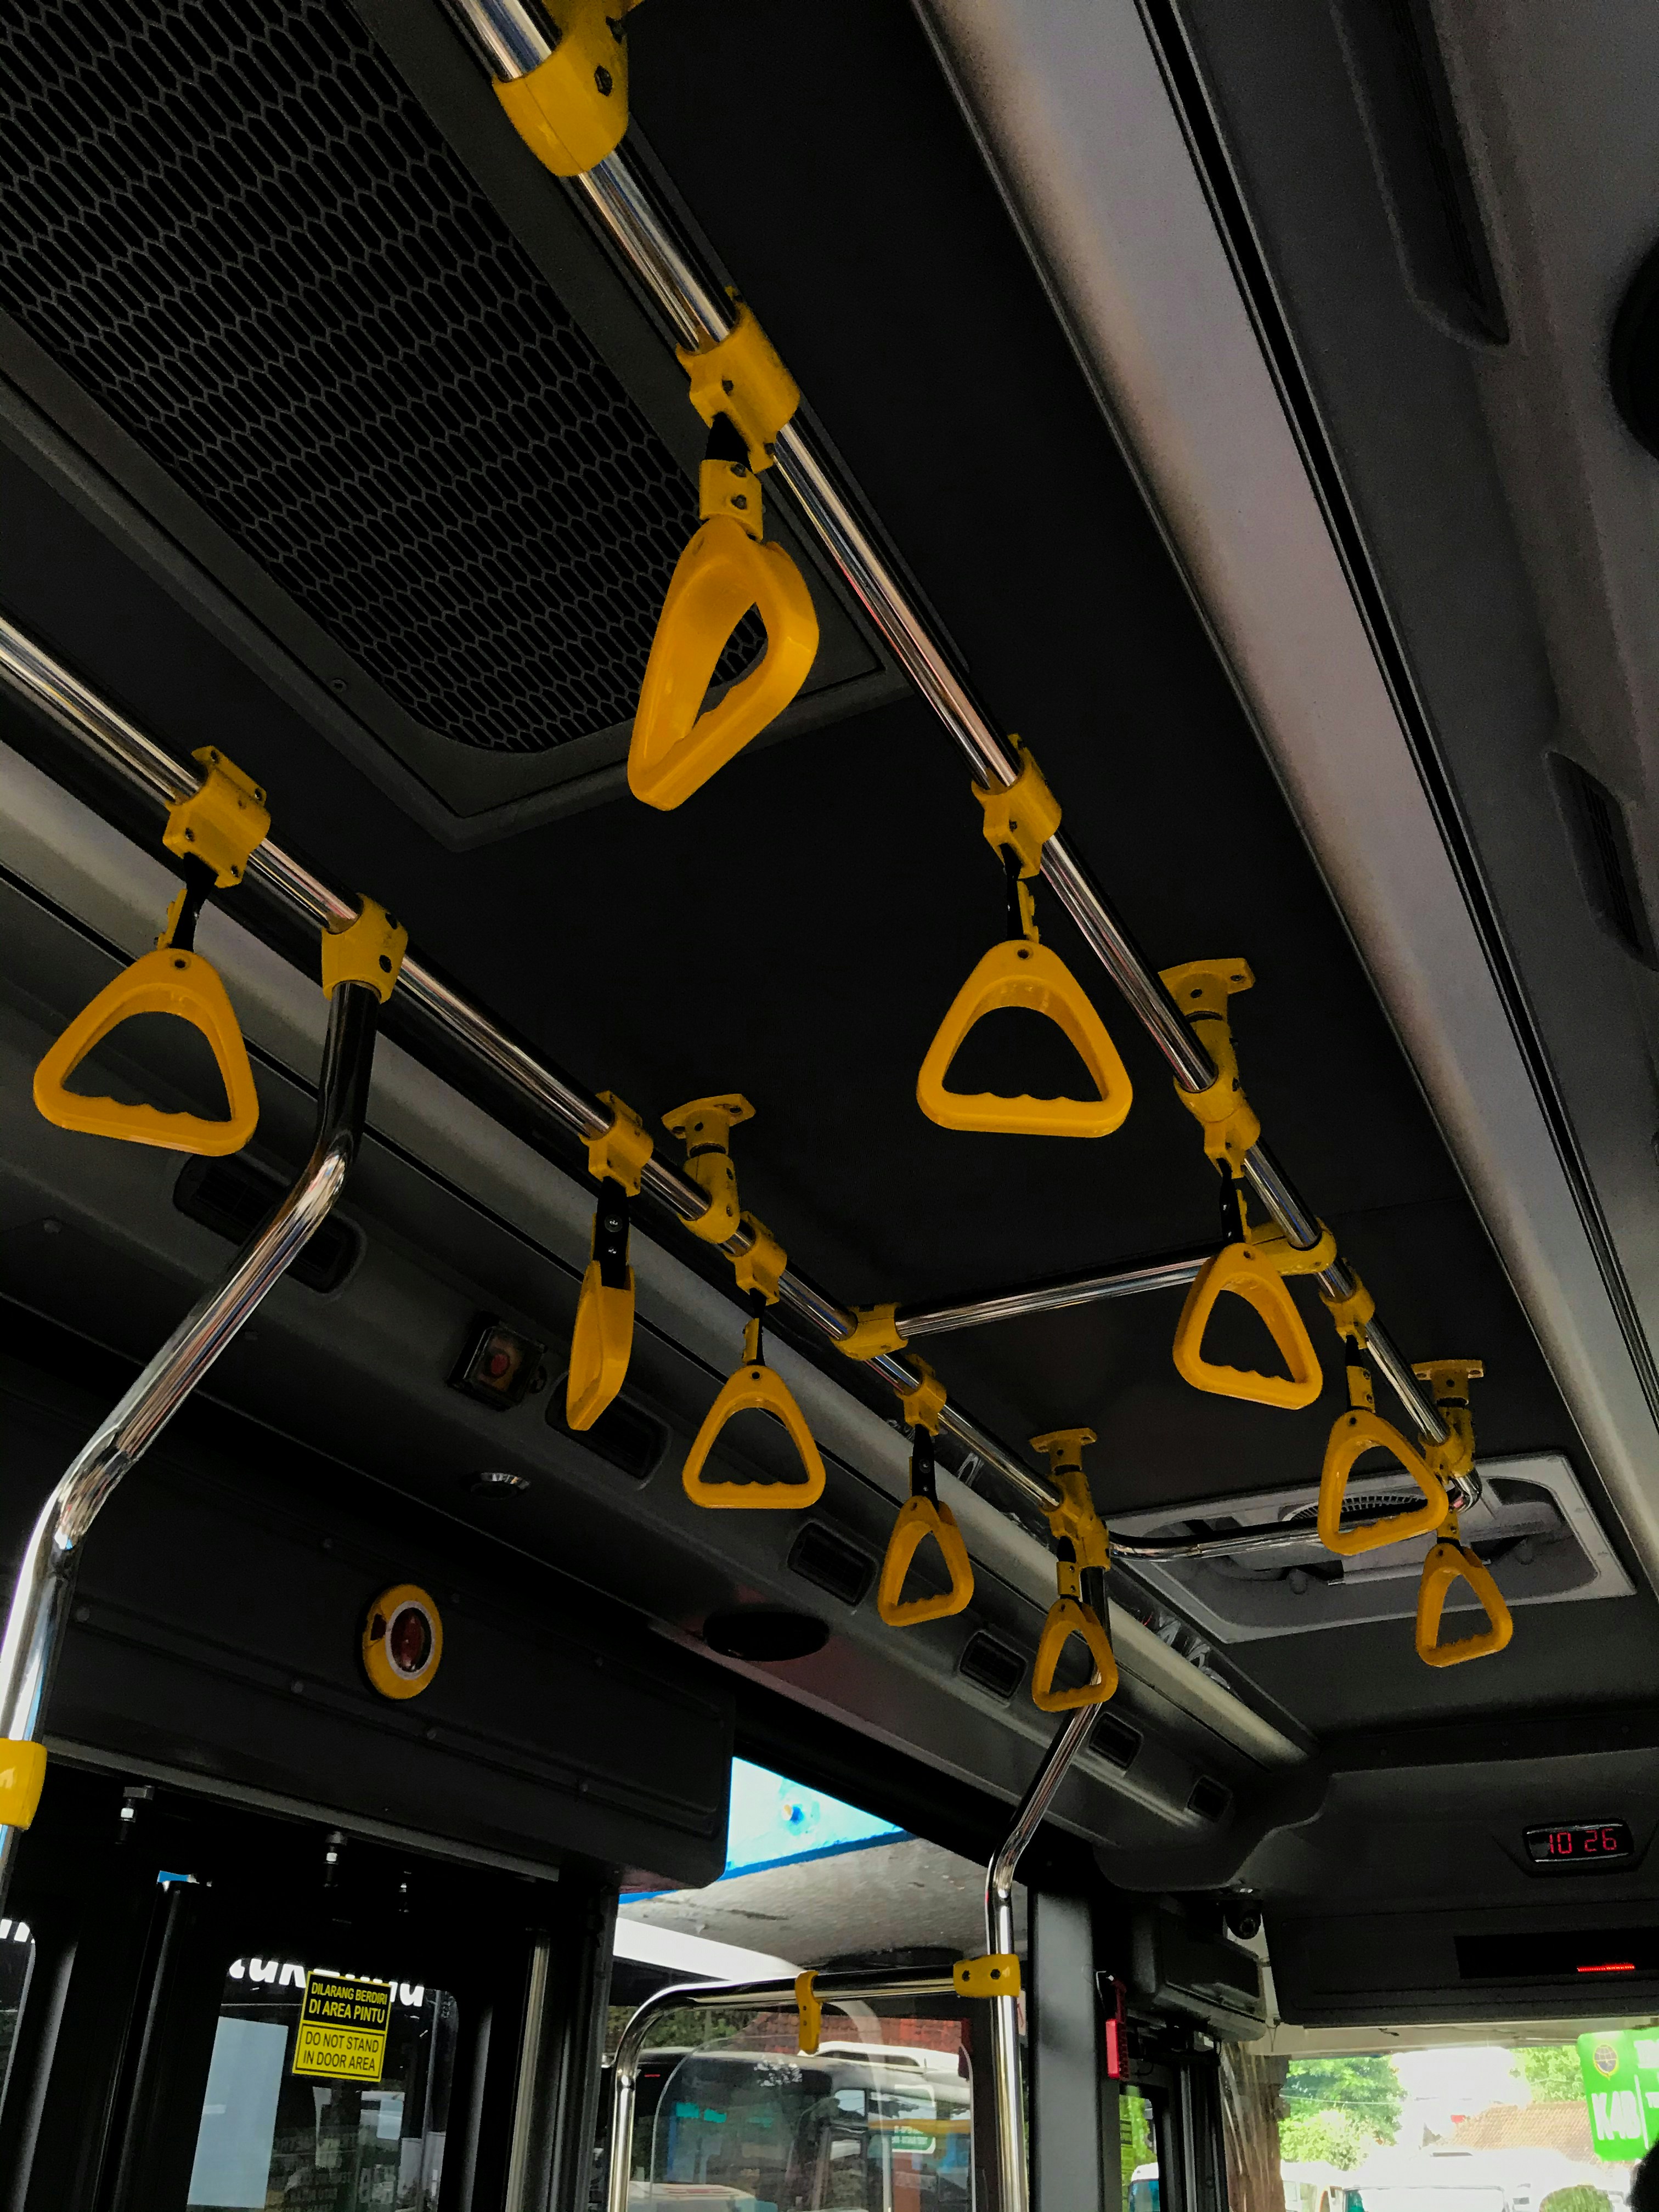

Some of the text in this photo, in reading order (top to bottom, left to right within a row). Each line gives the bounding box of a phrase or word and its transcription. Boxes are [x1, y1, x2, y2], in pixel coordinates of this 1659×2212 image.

[1549, 1829, 1617, 1854] 10 26
[311, 1982, 388, 2005] DILARANG BERDIRI
[308, 1999, 385, 2023] DI AREA PINTU
[305, 2031, 379, 2053] DO NOT STAND
[303, 2050, 375, 2072] IN DOOR AREA
